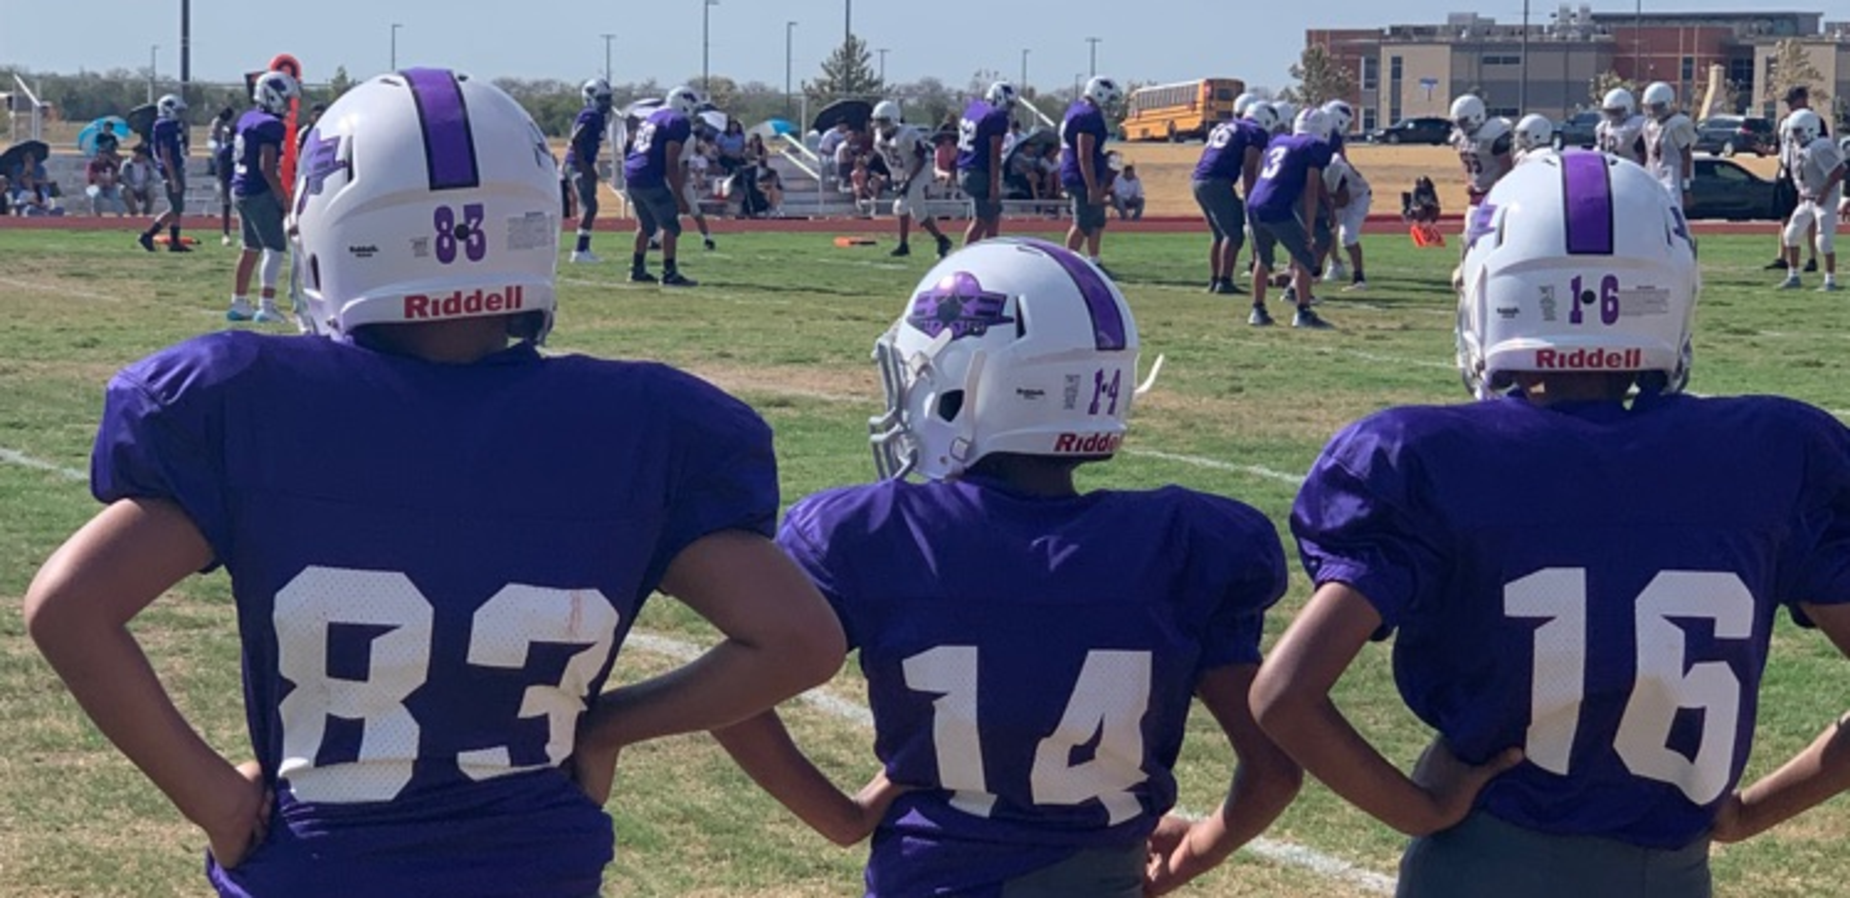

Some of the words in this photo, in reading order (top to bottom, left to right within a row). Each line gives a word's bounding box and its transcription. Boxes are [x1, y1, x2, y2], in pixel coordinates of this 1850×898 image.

[1261, 145, 1288, 179] 3
[433, 203, 486, 264] 83
[403, 286, 522, 319] Riddell
[1569, 274, 1620, 325] 16
[1535, 348, 1641, 368] Riddell
[1087, 367, 1121, 415] 14
[273, 565, 620, 804] 83
[1504, 567, 1755, 805] 16
[902, 645, 1152, 827] 14
